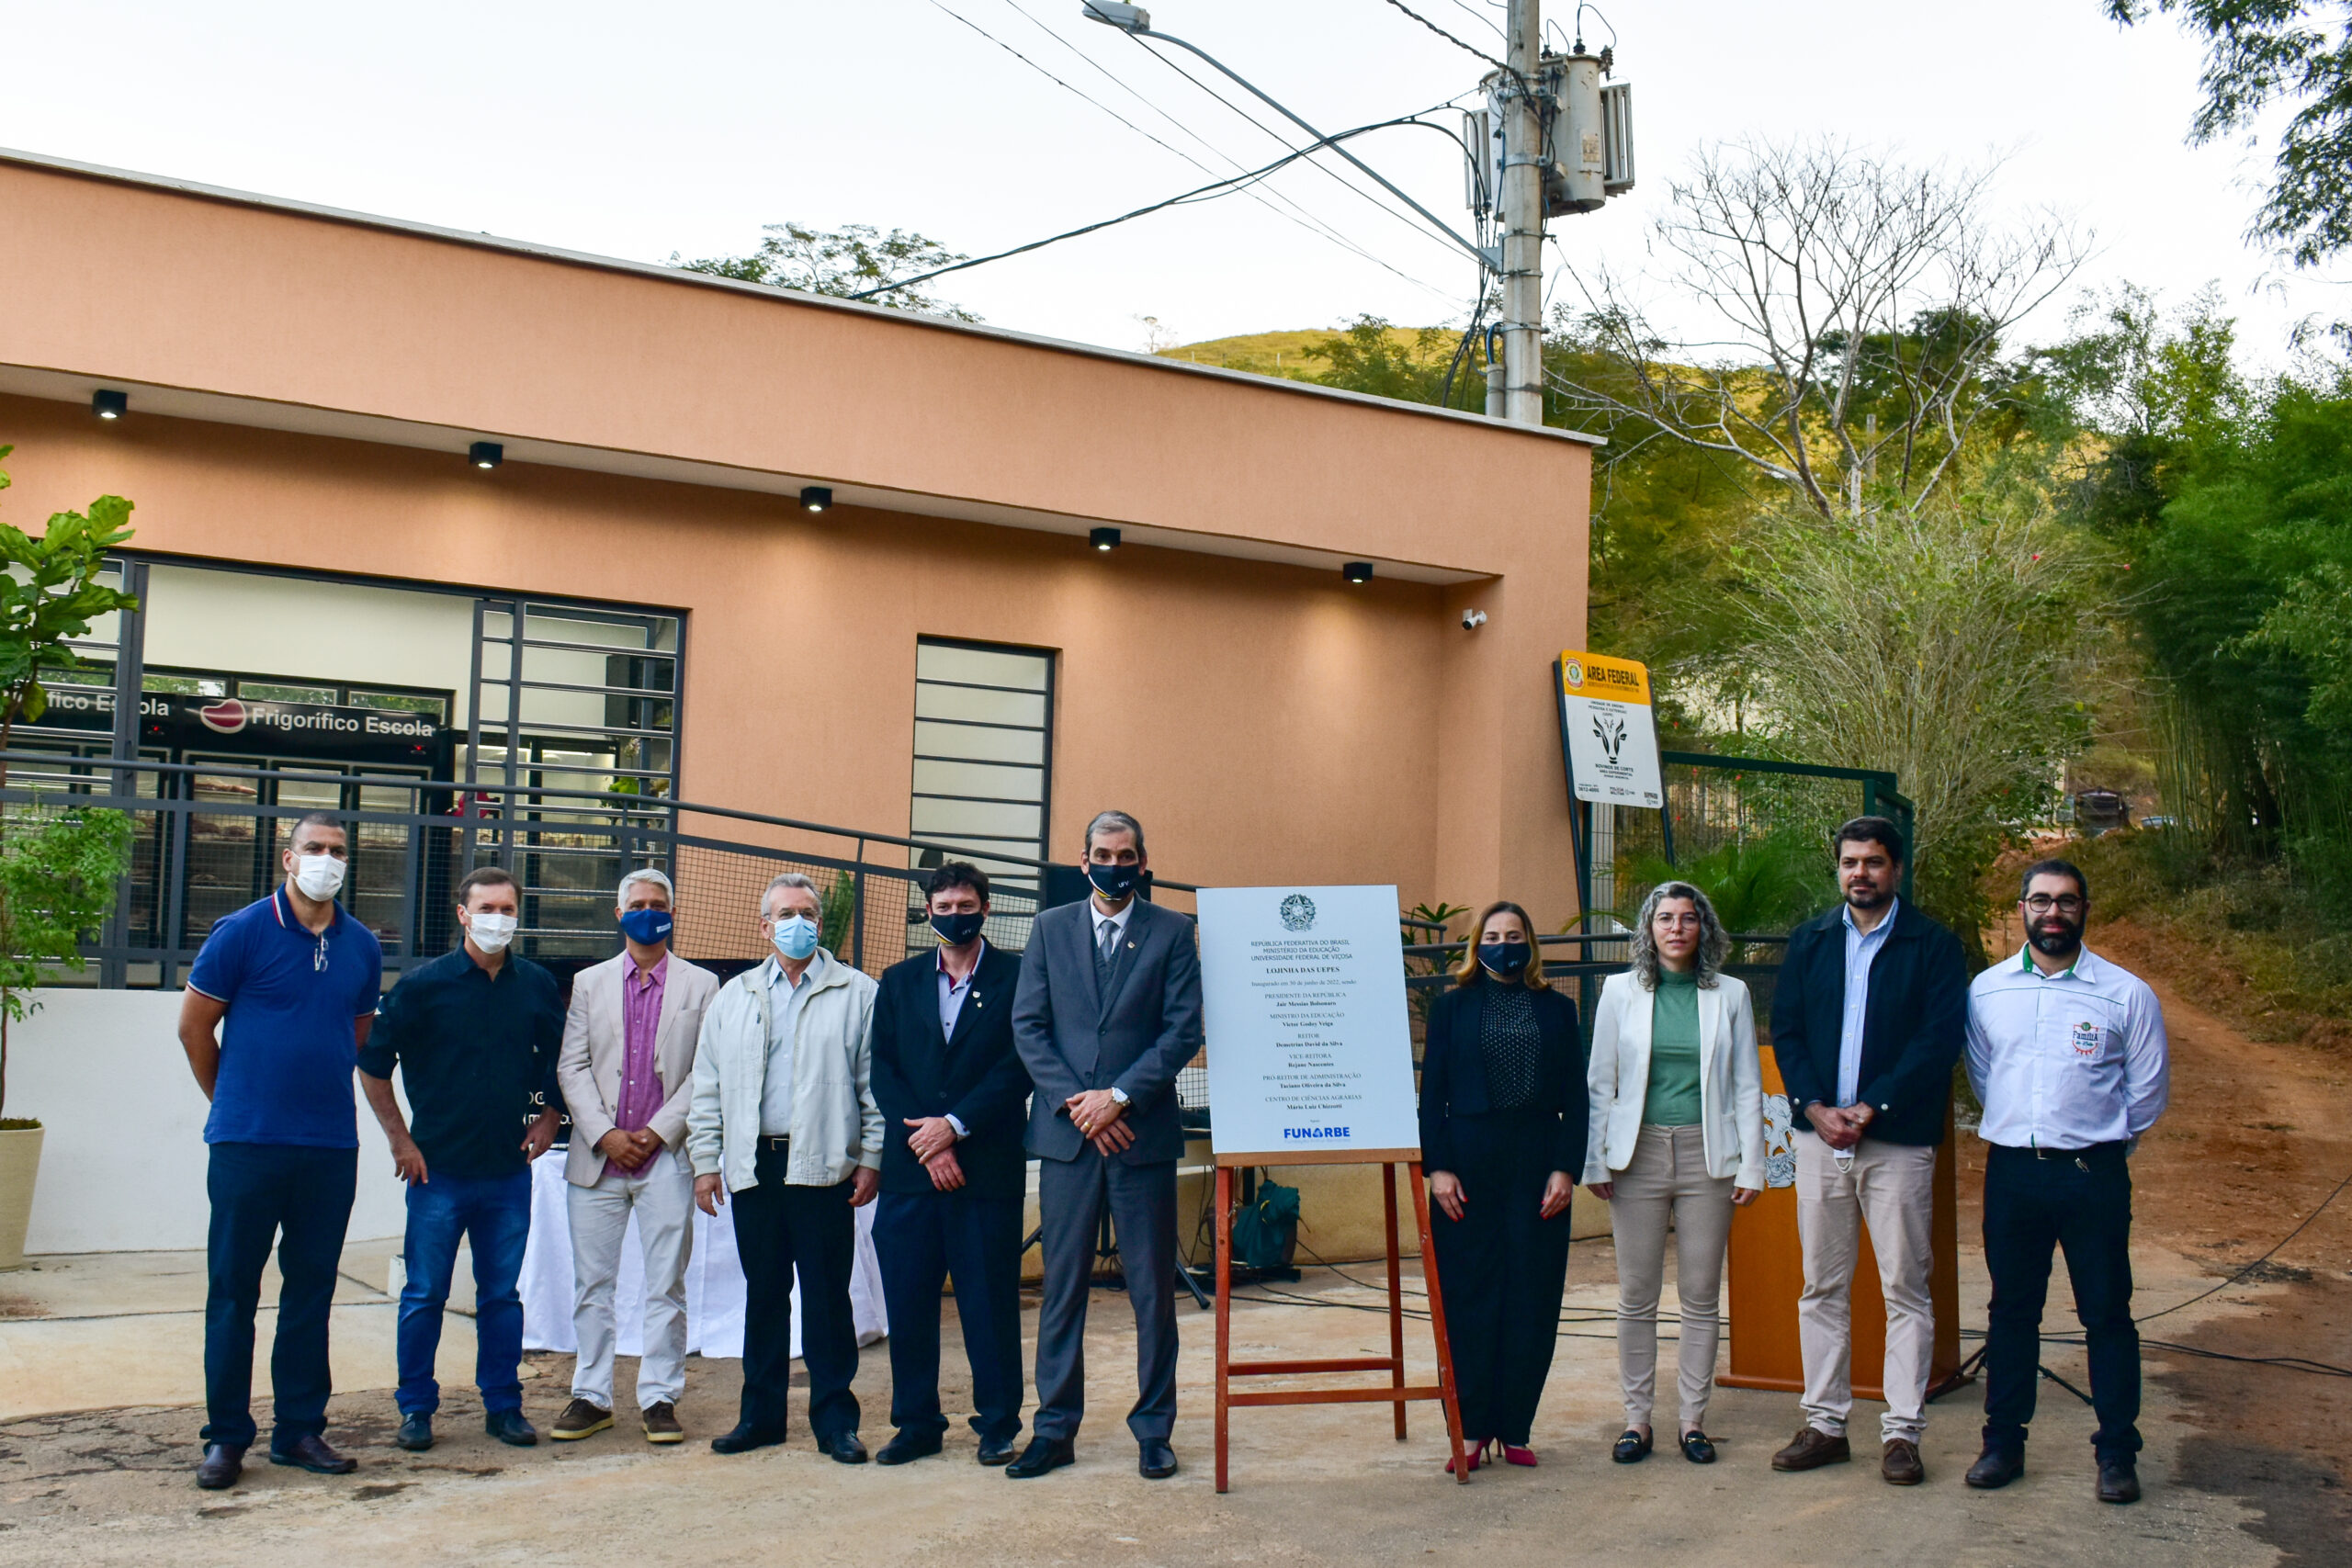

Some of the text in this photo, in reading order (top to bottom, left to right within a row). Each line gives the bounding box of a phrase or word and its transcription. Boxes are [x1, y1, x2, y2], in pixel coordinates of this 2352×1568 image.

[1607, 669, 1639, 686] FEDERAL
[96, 694, 169, 716] Eola
[252, 707, 434, 737] Frigorífico Escola
[1309, 1072, 1362, 1080] ADMINISTRAÇÃO
[1283, 1127, 1351, 1139] FUNARBE
